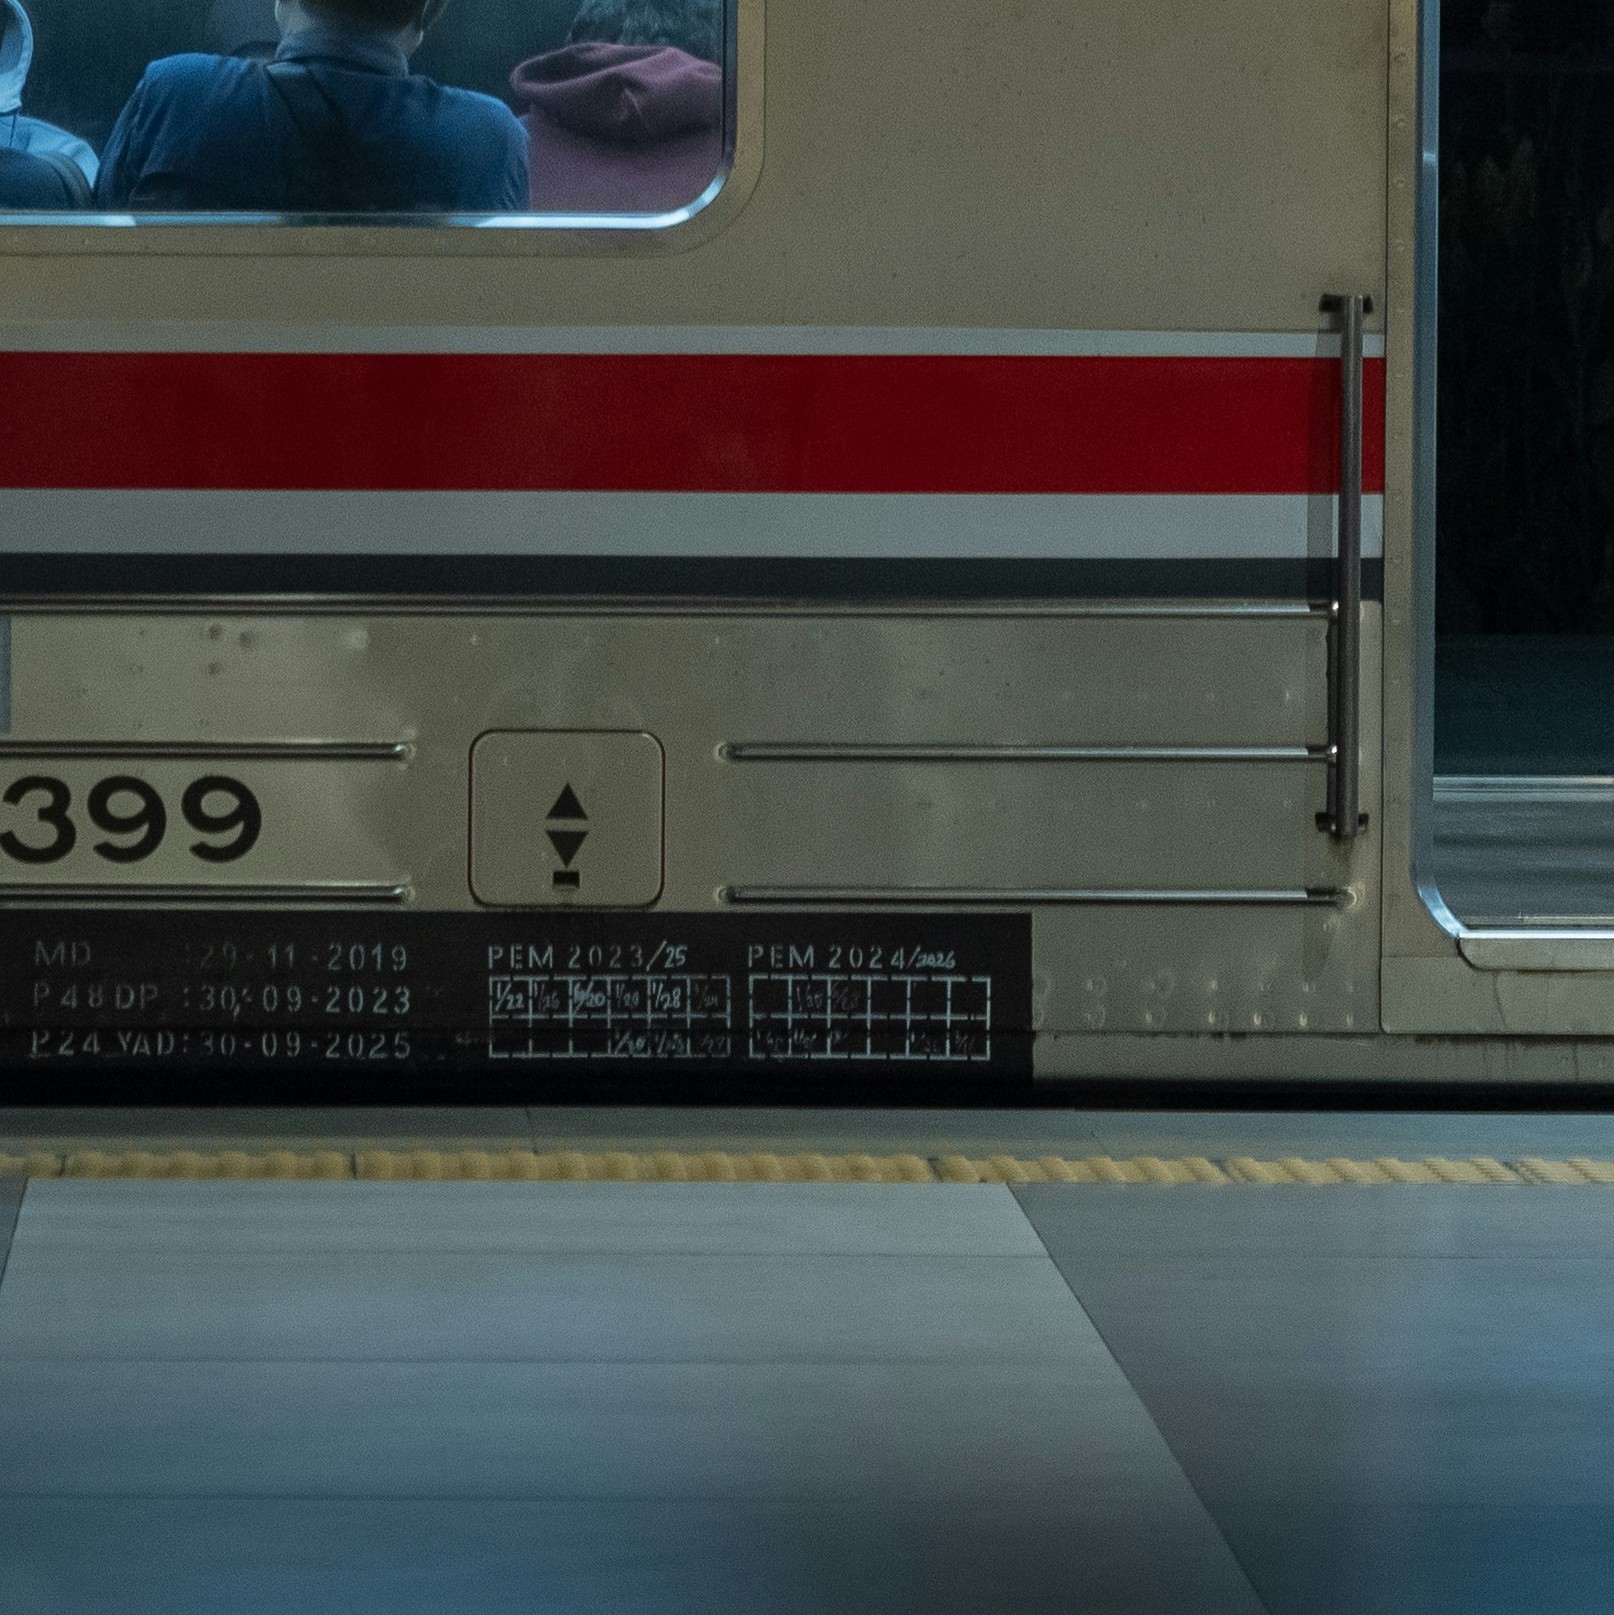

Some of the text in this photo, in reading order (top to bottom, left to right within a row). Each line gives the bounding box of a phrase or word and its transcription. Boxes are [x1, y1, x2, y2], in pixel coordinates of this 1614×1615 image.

[33, 939, 92, 967] MD
[488, 943, 555, 970] PEM
[747, 944, 816, 969] PEM
